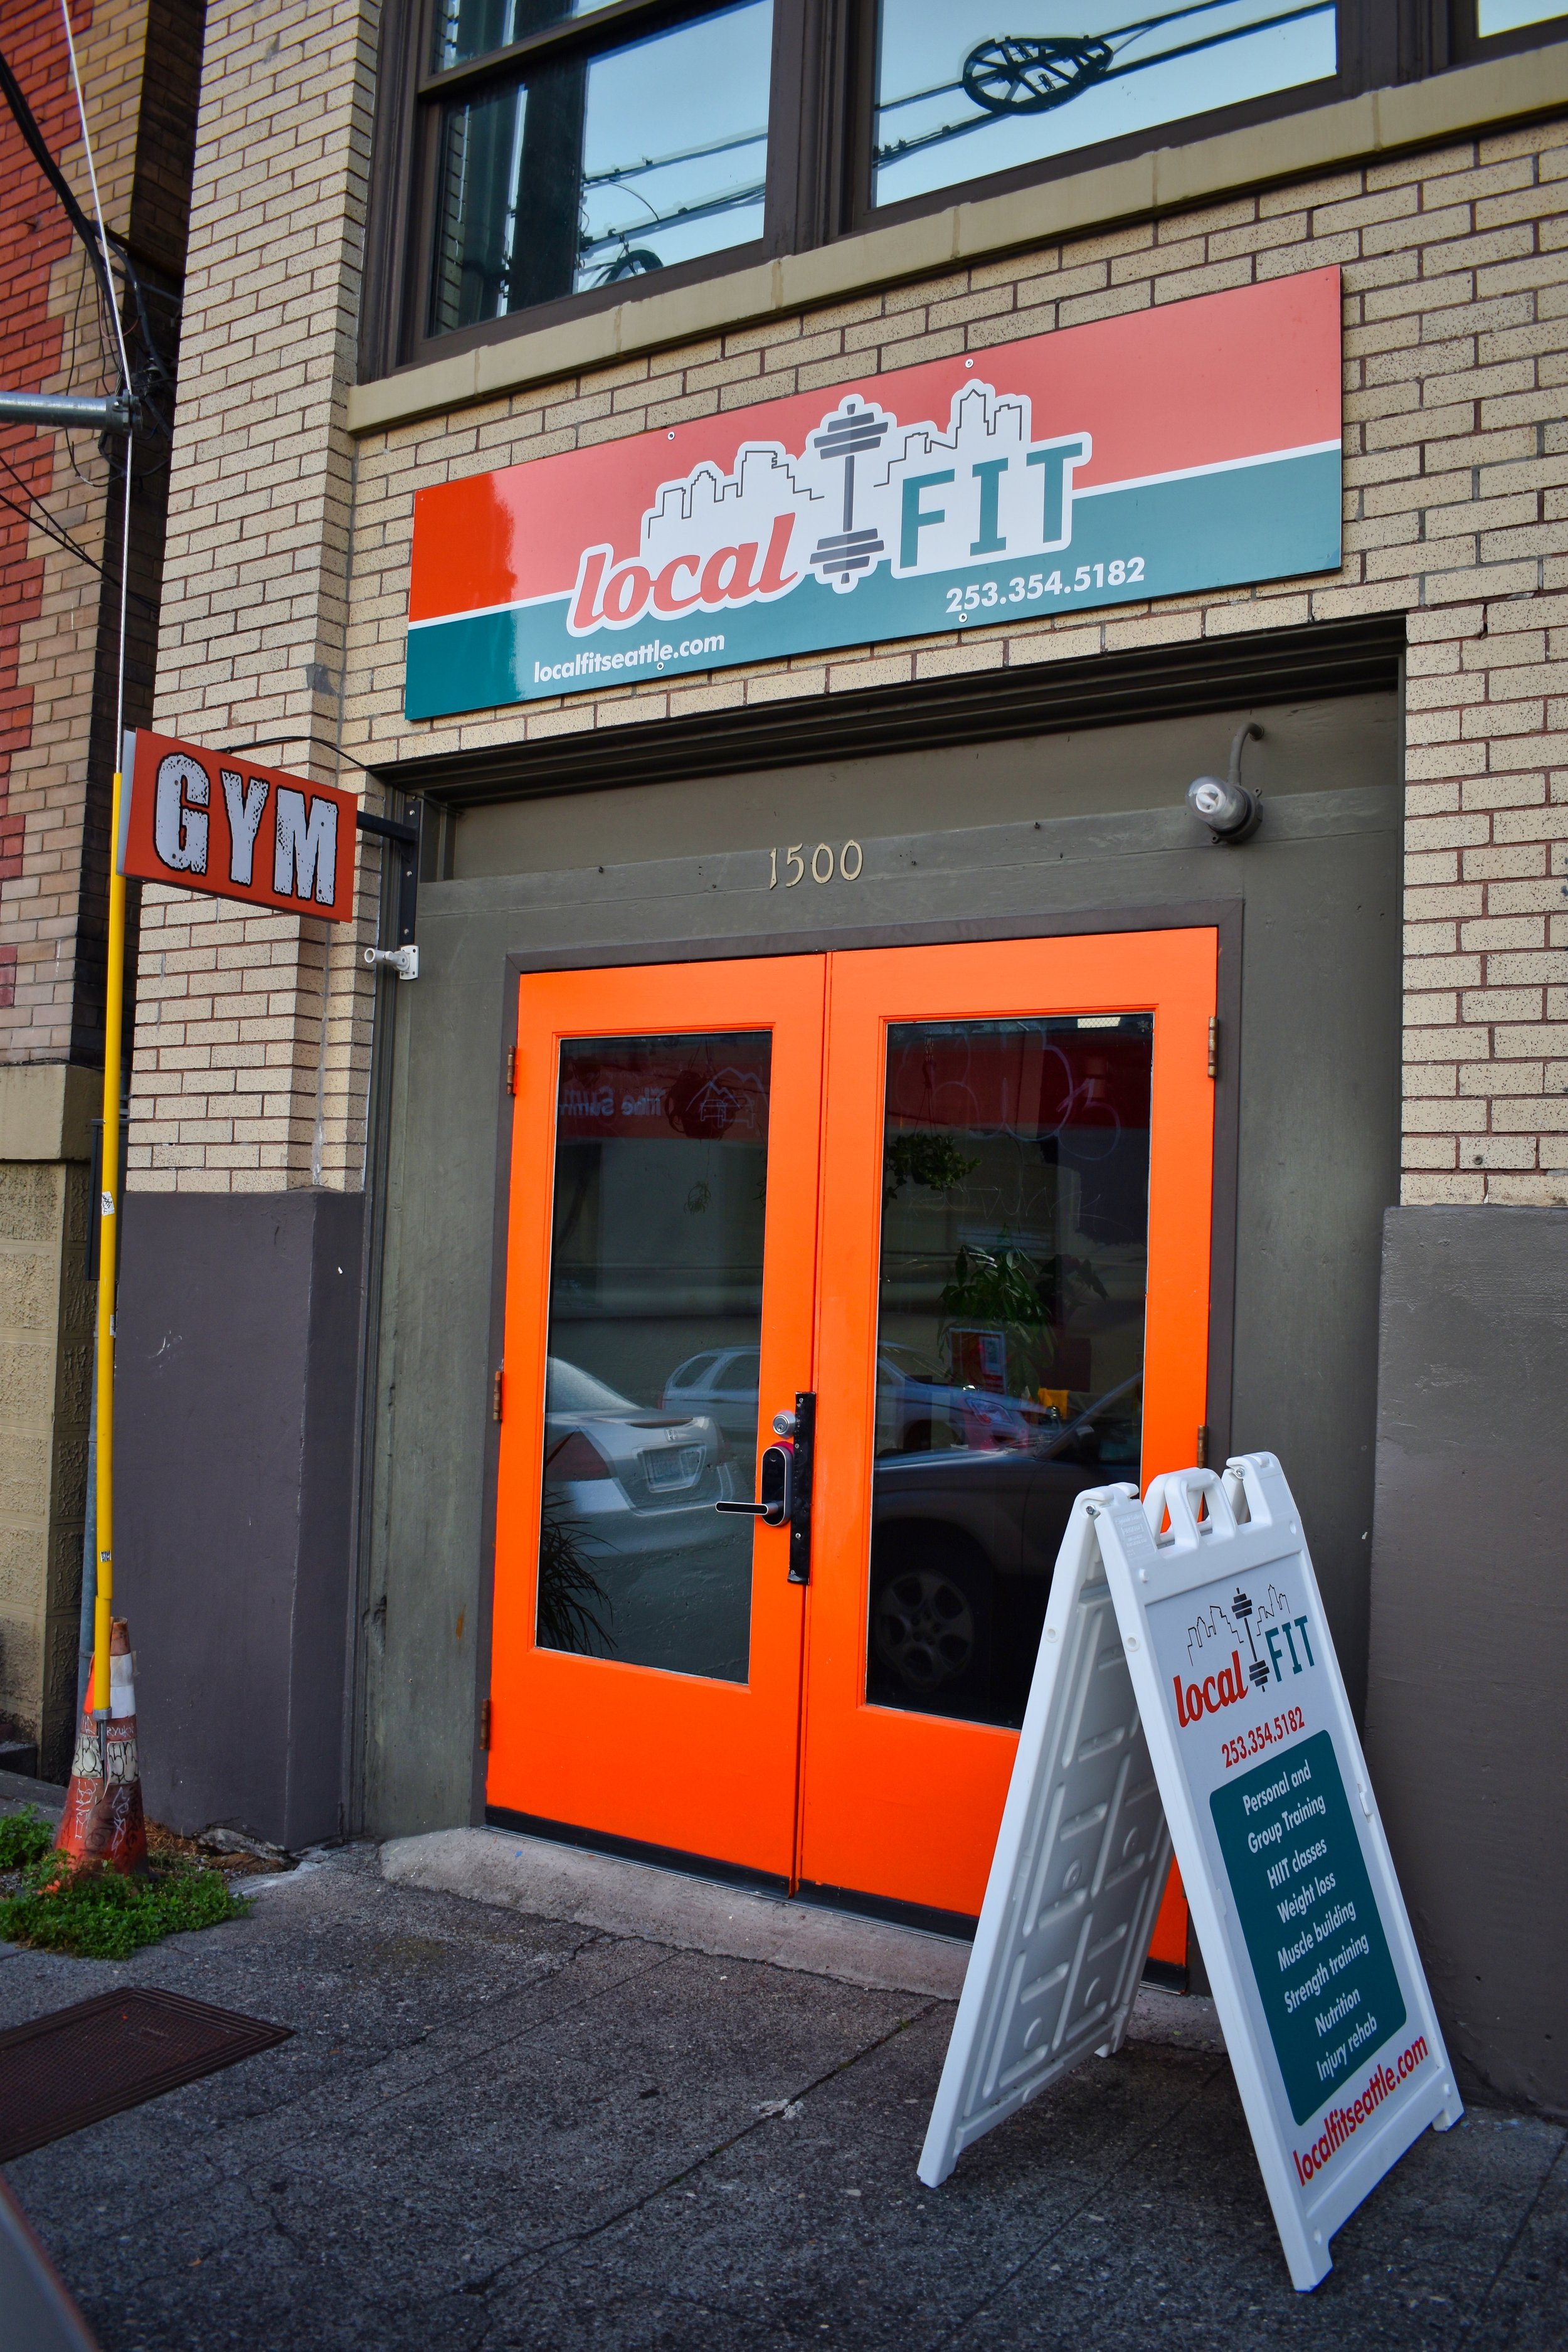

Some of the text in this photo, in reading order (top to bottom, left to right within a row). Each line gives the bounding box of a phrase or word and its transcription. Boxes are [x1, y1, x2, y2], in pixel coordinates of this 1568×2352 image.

[573, 442, 1083, 628] local FIT
[945, 556, 1146, 613] 253.354.5182
[533, 633, 725, 683] localfitseattle.com
[153, 752, 338, 906] GYM
[770, 839, 864, 889] 1500
[1173, 1615, 1315, 1728] local FIT
[1221, 1706, 1305, 1769] 253.354.5182
[1242, 1759, 1311, 1816] Personal and
[1248, 1795, 1327, 1853] Group Training
[1266, 1839, 1327, 1889] HIIT classes
[1276, 1872, 1336, 1923] Weight loss
[1278, 1901, 1356, 1972] Muscle building
[1284, 1934, 1369, 2013] Strength training
[1315, 1988, 1361, 2037] Nutrition
[1316, 2012, 1378, 2081] Injury rehab
[1293, 2035, 1429, 2188] localfitseattle.com
